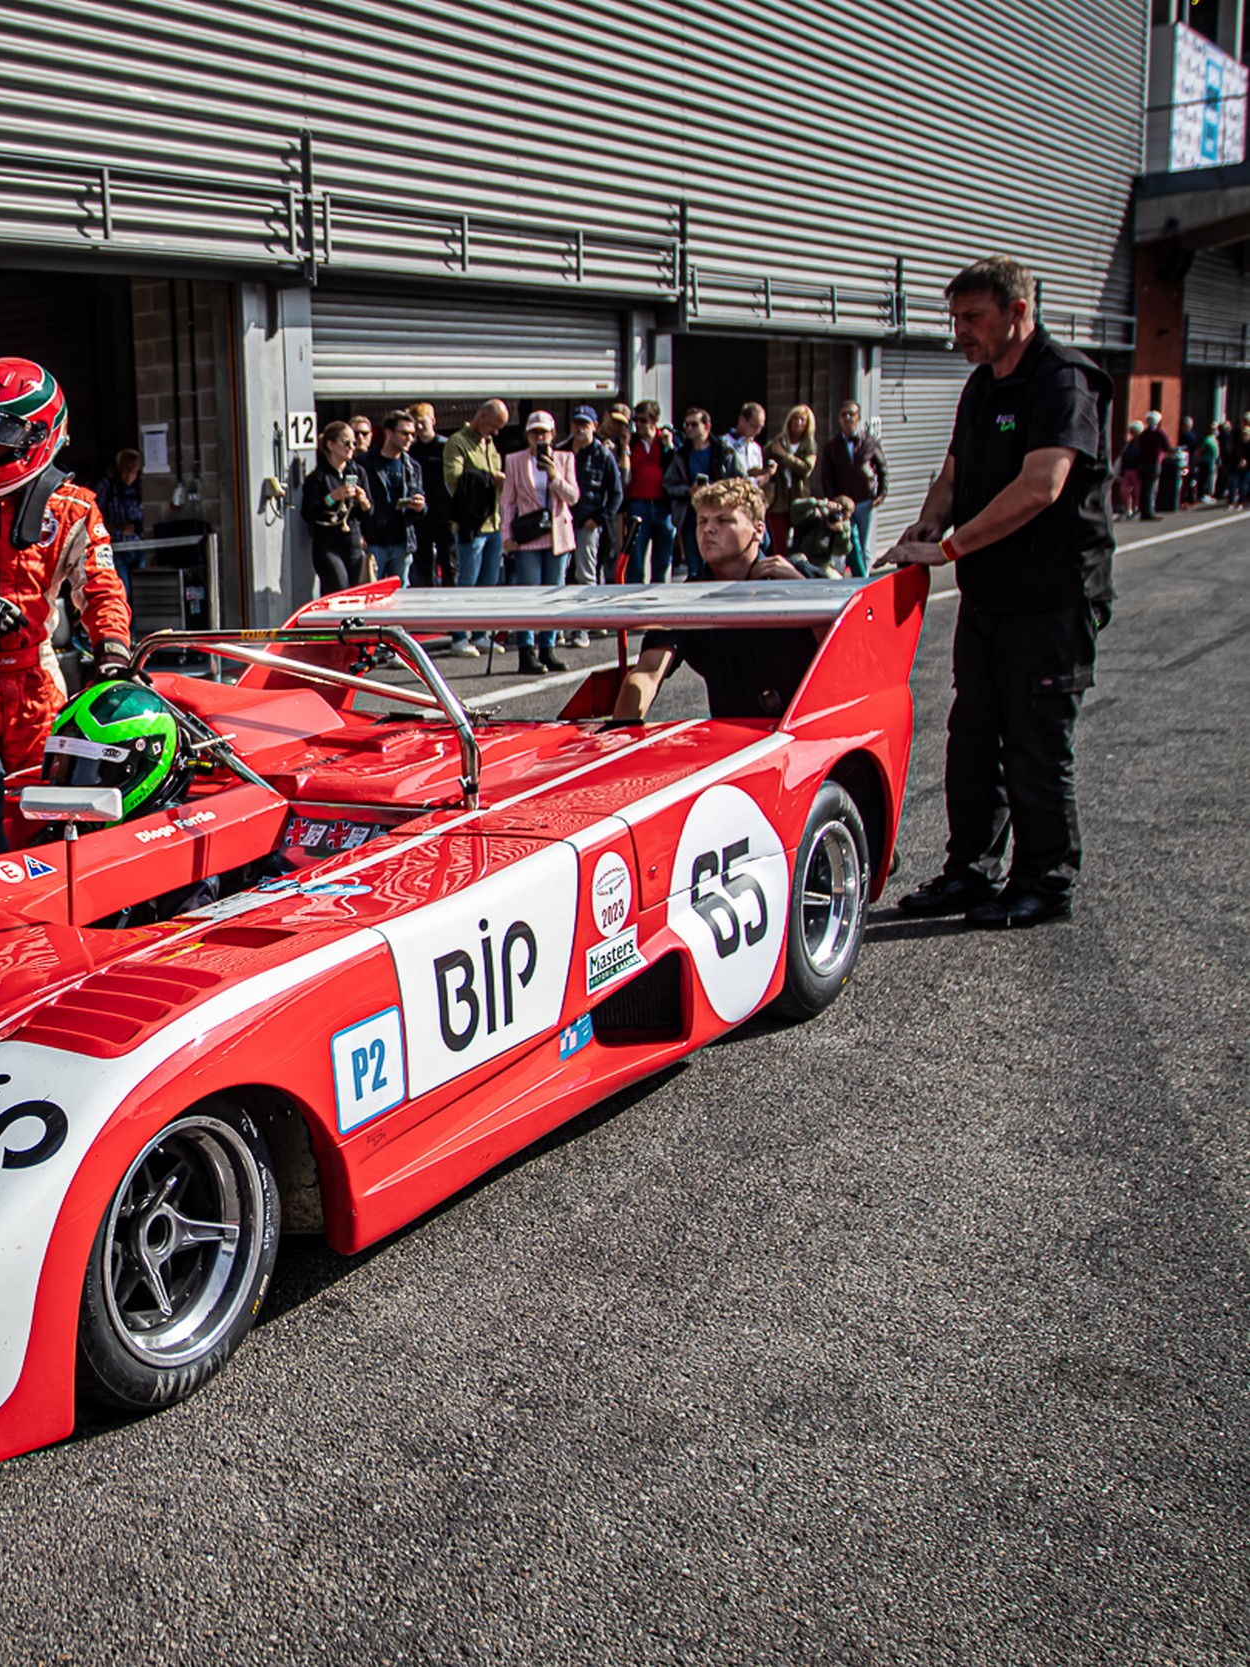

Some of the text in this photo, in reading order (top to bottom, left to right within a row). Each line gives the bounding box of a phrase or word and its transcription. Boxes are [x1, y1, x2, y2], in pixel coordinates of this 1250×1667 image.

[291, 416, 314, 443] 12
[134, 824, 177, 843] Diogo
[0, 864, 19, 879] E
[601, 898, 625, 929] 2023
[691, 837, 767, 959] 65
[589, 938, 635, 976] Masters
[351, 1038, 388, 1102] P2
